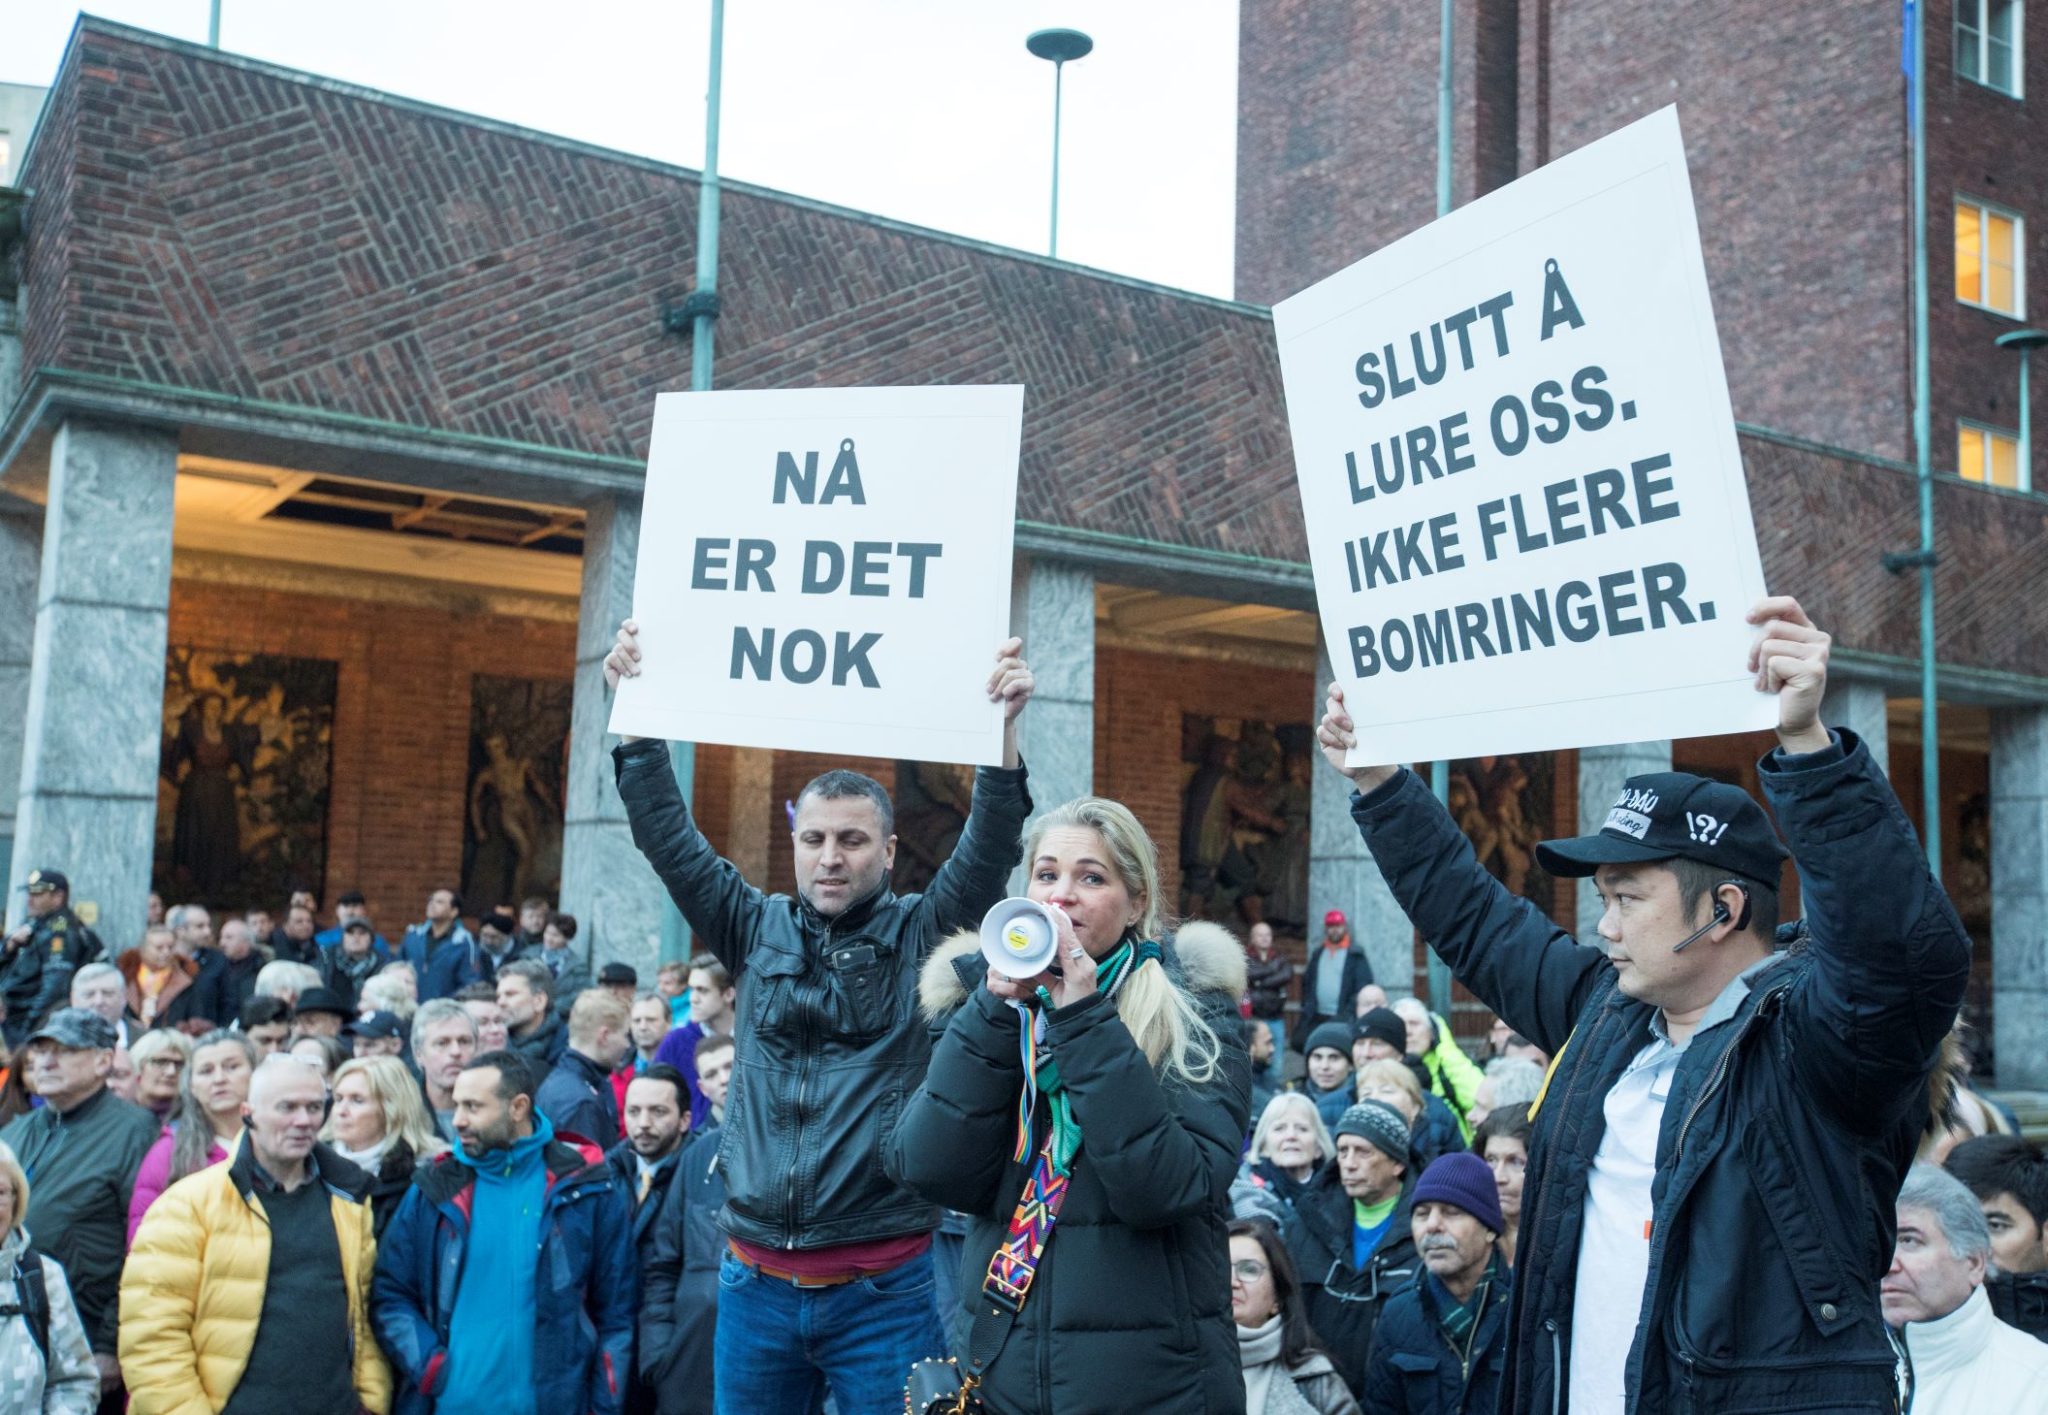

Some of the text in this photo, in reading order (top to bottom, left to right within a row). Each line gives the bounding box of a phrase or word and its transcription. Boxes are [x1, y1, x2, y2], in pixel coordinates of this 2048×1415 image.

[1355, 257, 1586, 409] SLUTT Å
[772, 437, 867, 505] NÅ
[1344, 365, 1638, 505] LURE OSS.
[691, 537, 943, 599] ER DET
[1344, 452, 1681, 593] IKKE FLERE
[729, 626, 884, 689] NOK
[1347, 561, 1718, 679] BOMRINGER.
